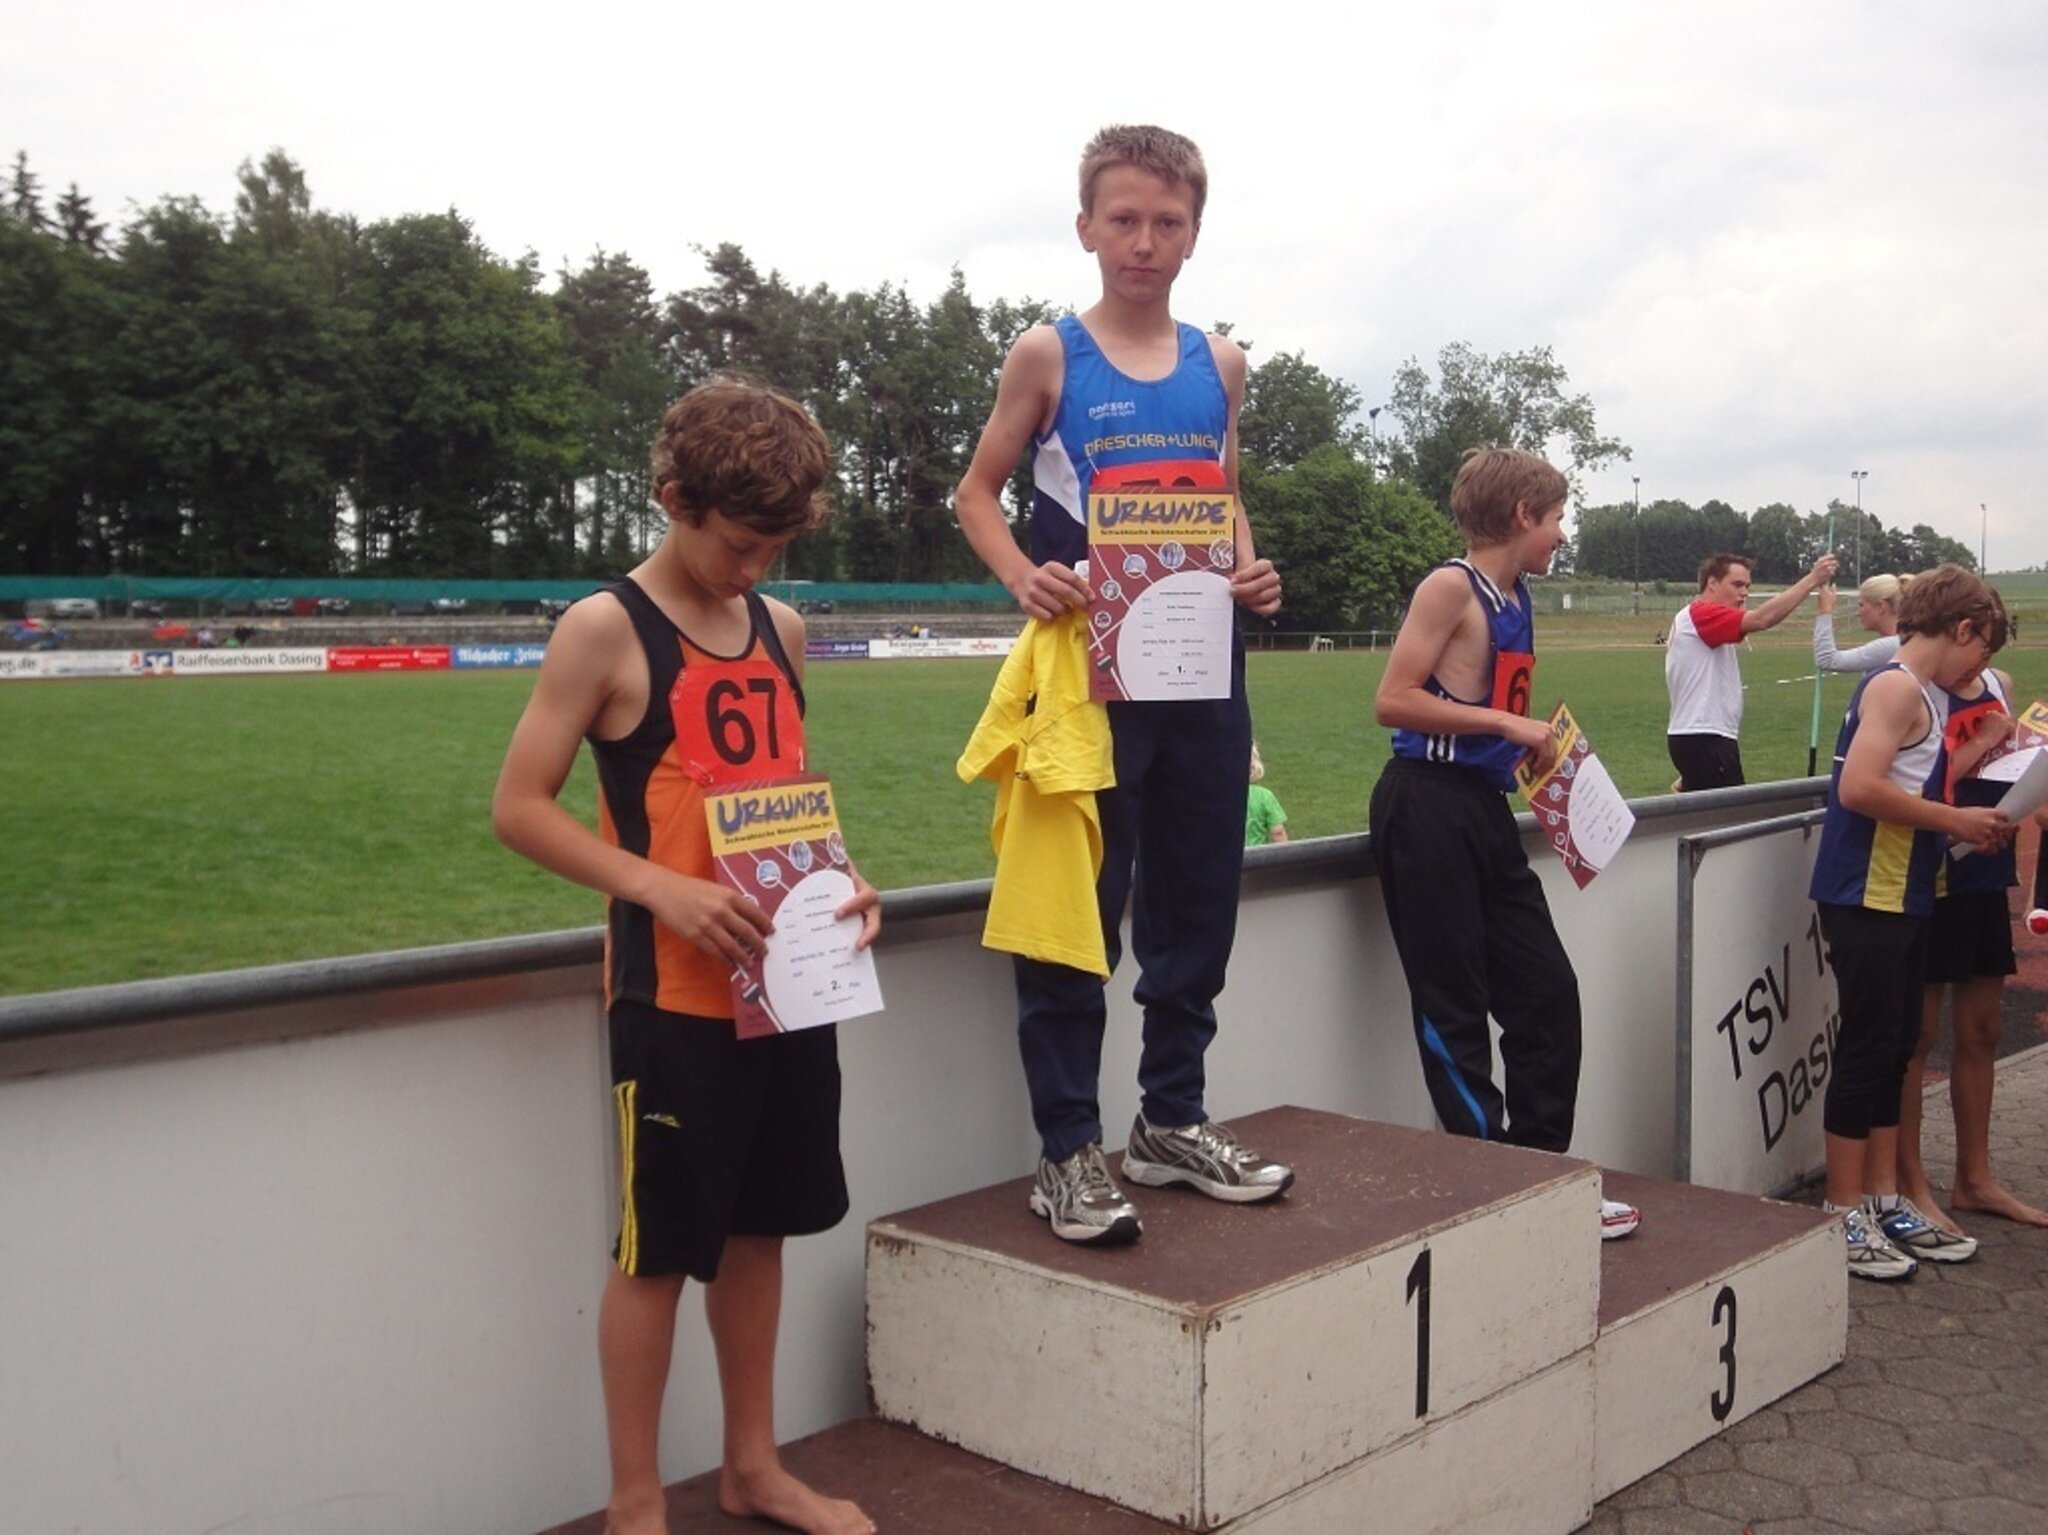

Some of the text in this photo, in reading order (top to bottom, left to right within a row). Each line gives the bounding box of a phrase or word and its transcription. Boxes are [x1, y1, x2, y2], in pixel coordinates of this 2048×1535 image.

[1096, 498, 1227, 528] URKUNDE
[178, 652, 275, 668] Raiffeisenbank
[278, 651, 322, 667] Dasing
[706, 678, 780, 765] 67
[717, 790, 831, 836] URKUNDE
[1716, 942, 1790, 1082] TSV
[1406, 1248, 1432, 1420] 1
[1710, 1286, 1737, 1422] 3
